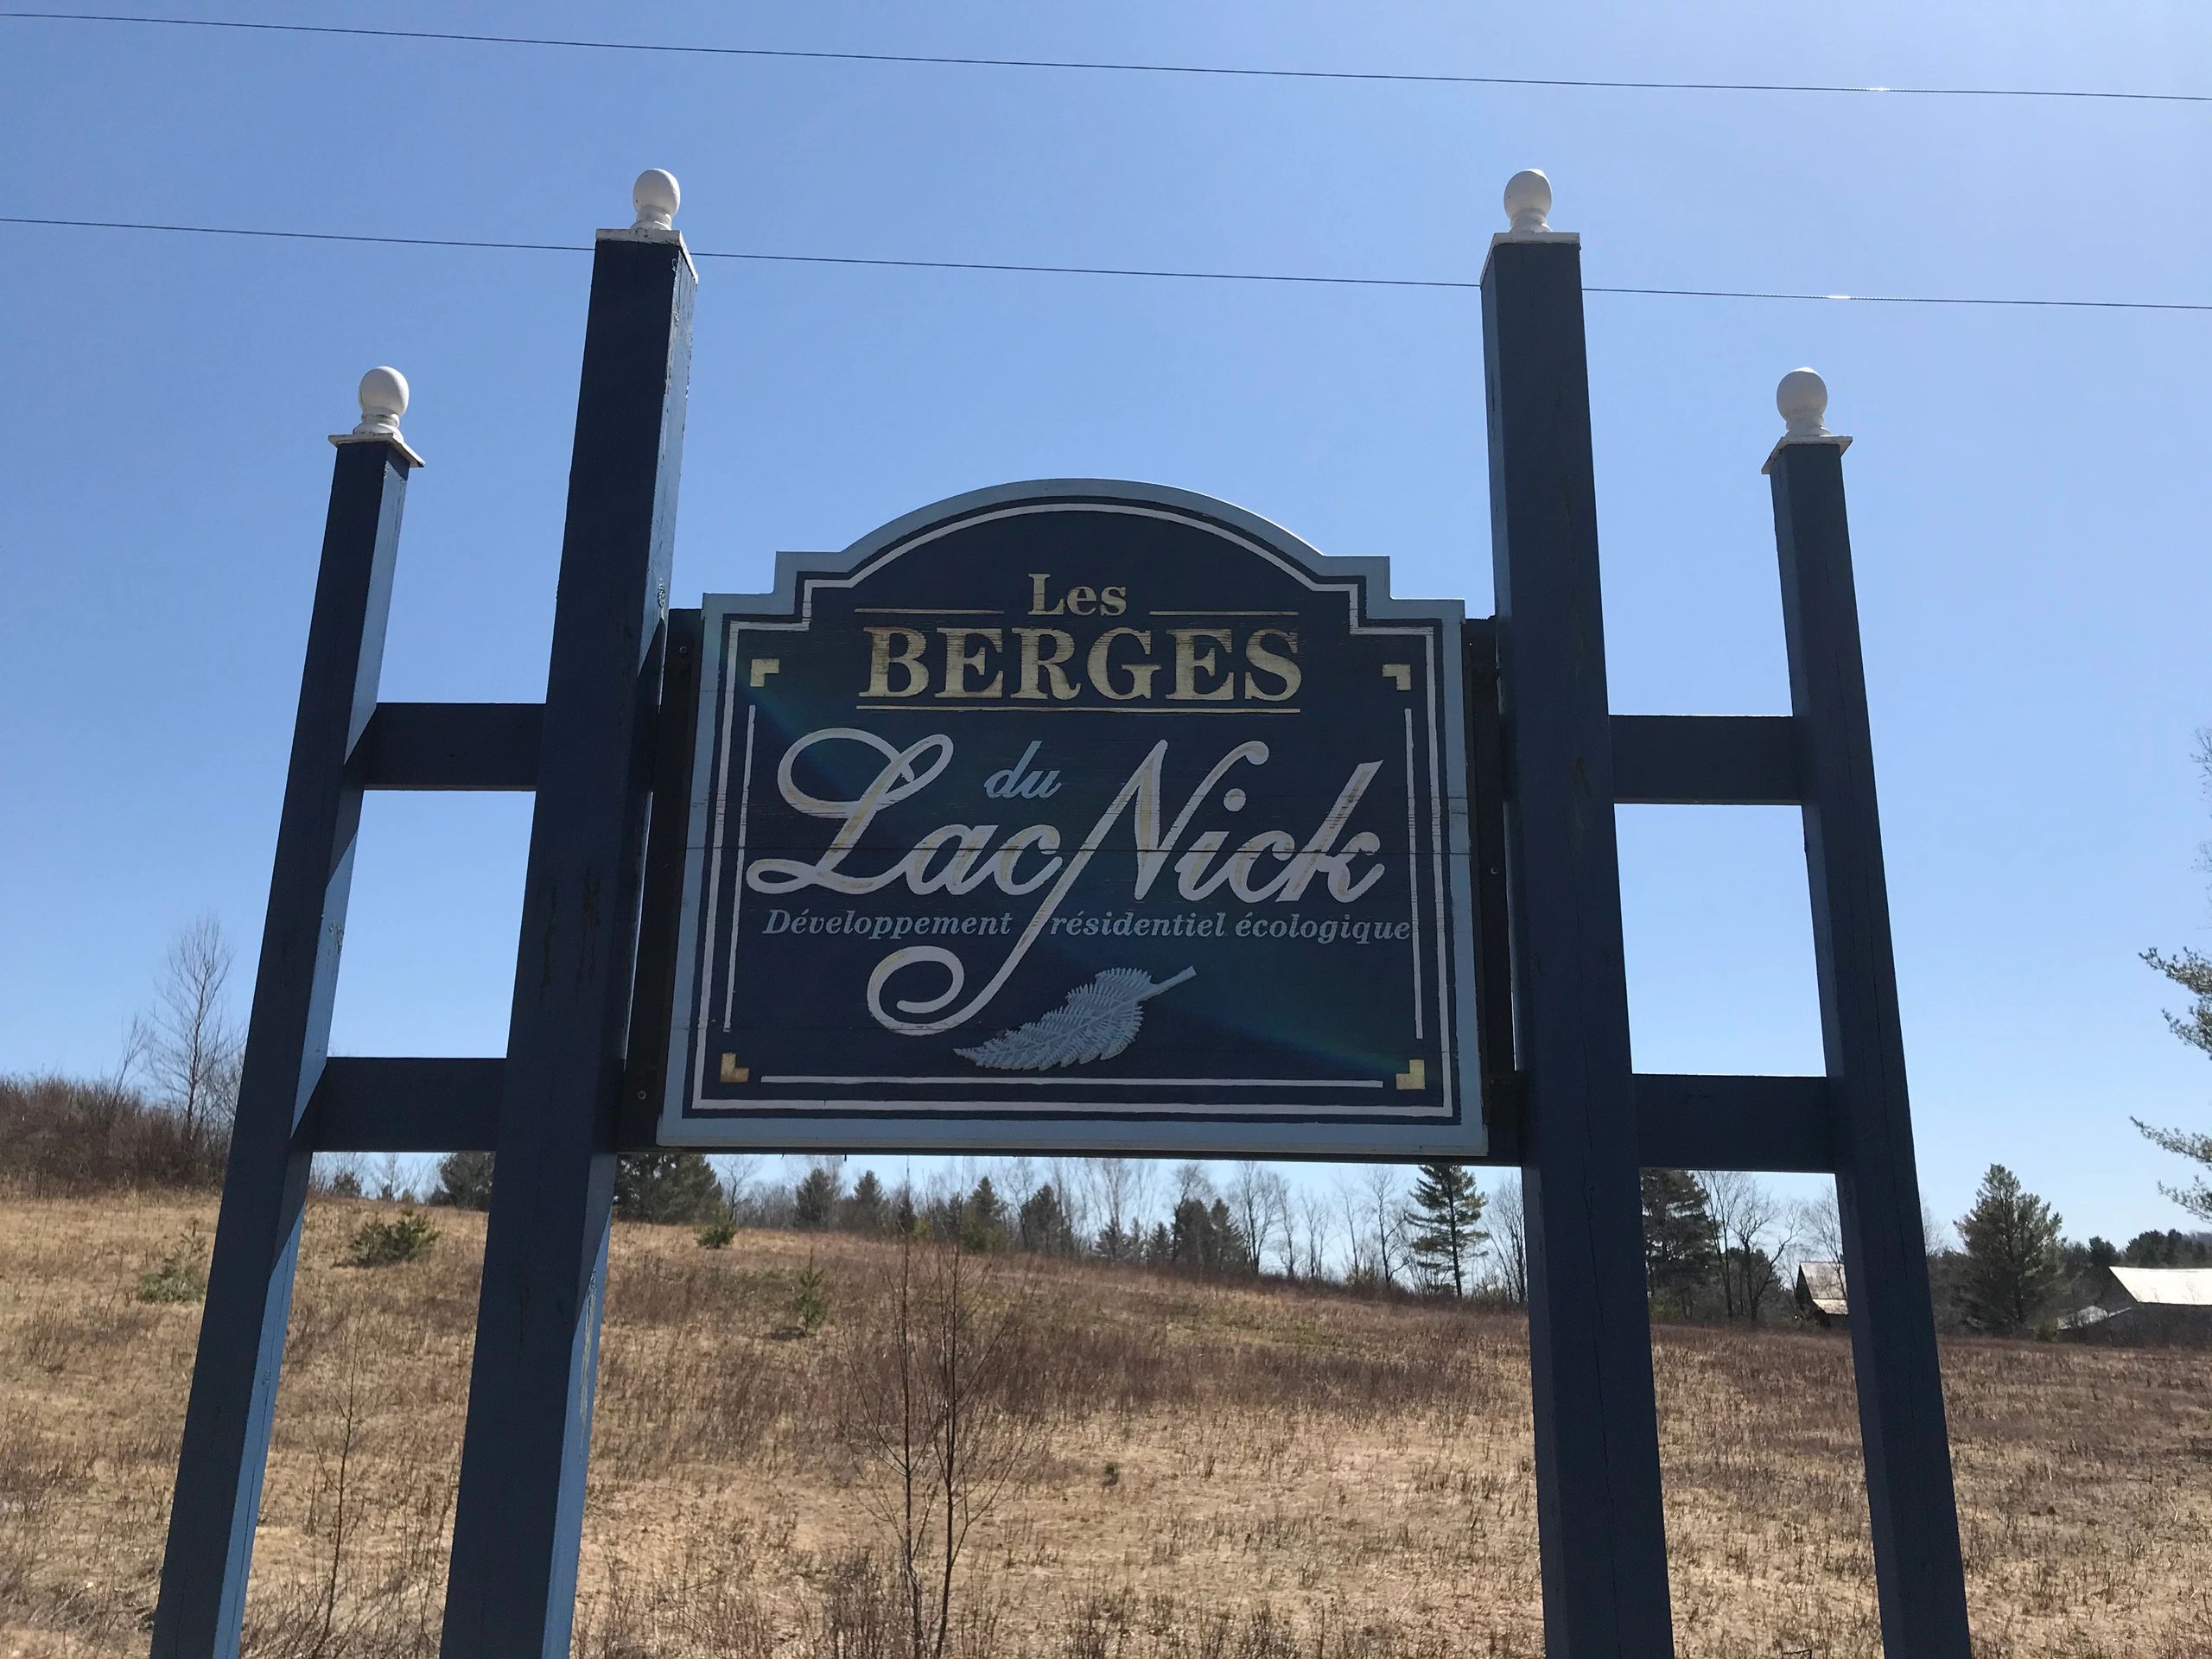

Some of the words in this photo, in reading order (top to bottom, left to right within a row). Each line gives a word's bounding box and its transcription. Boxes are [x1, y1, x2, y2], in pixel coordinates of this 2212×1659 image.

[1027, 573, 1127, 617] Les
[858, 626, 1302, 702] BERGES
[983, 741, 1063, 799] du
[746, 728, 1064, 895] Lac
[762, 908, 1013, 939] Développement
[1050, 910, 1226, 938] résidentiel
[1235, 910, 1411, 944] écologique
